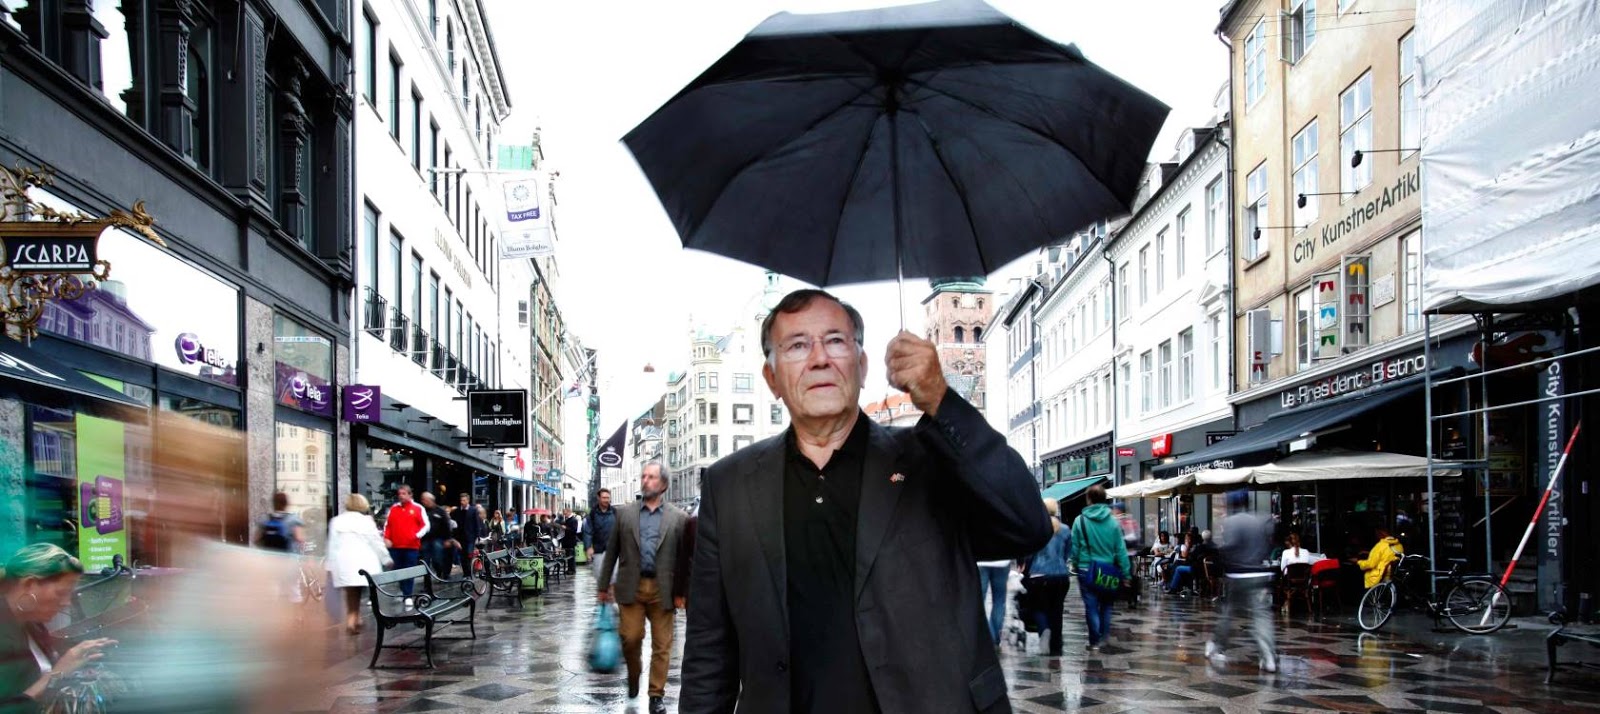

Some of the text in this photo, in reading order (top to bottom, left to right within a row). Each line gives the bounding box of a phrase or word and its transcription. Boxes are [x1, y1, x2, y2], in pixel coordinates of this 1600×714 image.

[523, 210, 537, 218] FREE
[13, 244, 89, 263] SCARPA
[1293, 237, 1316, 263] City
[1281, 391, 1294, 408] Le
[1372, 354, 1426, 383] Bistro
[305, 382, 321, 401] Telia
[472, 418, 522, 426] Illums Bolighus
[1545, 362, 1561, 557] City KunstneArtikler
